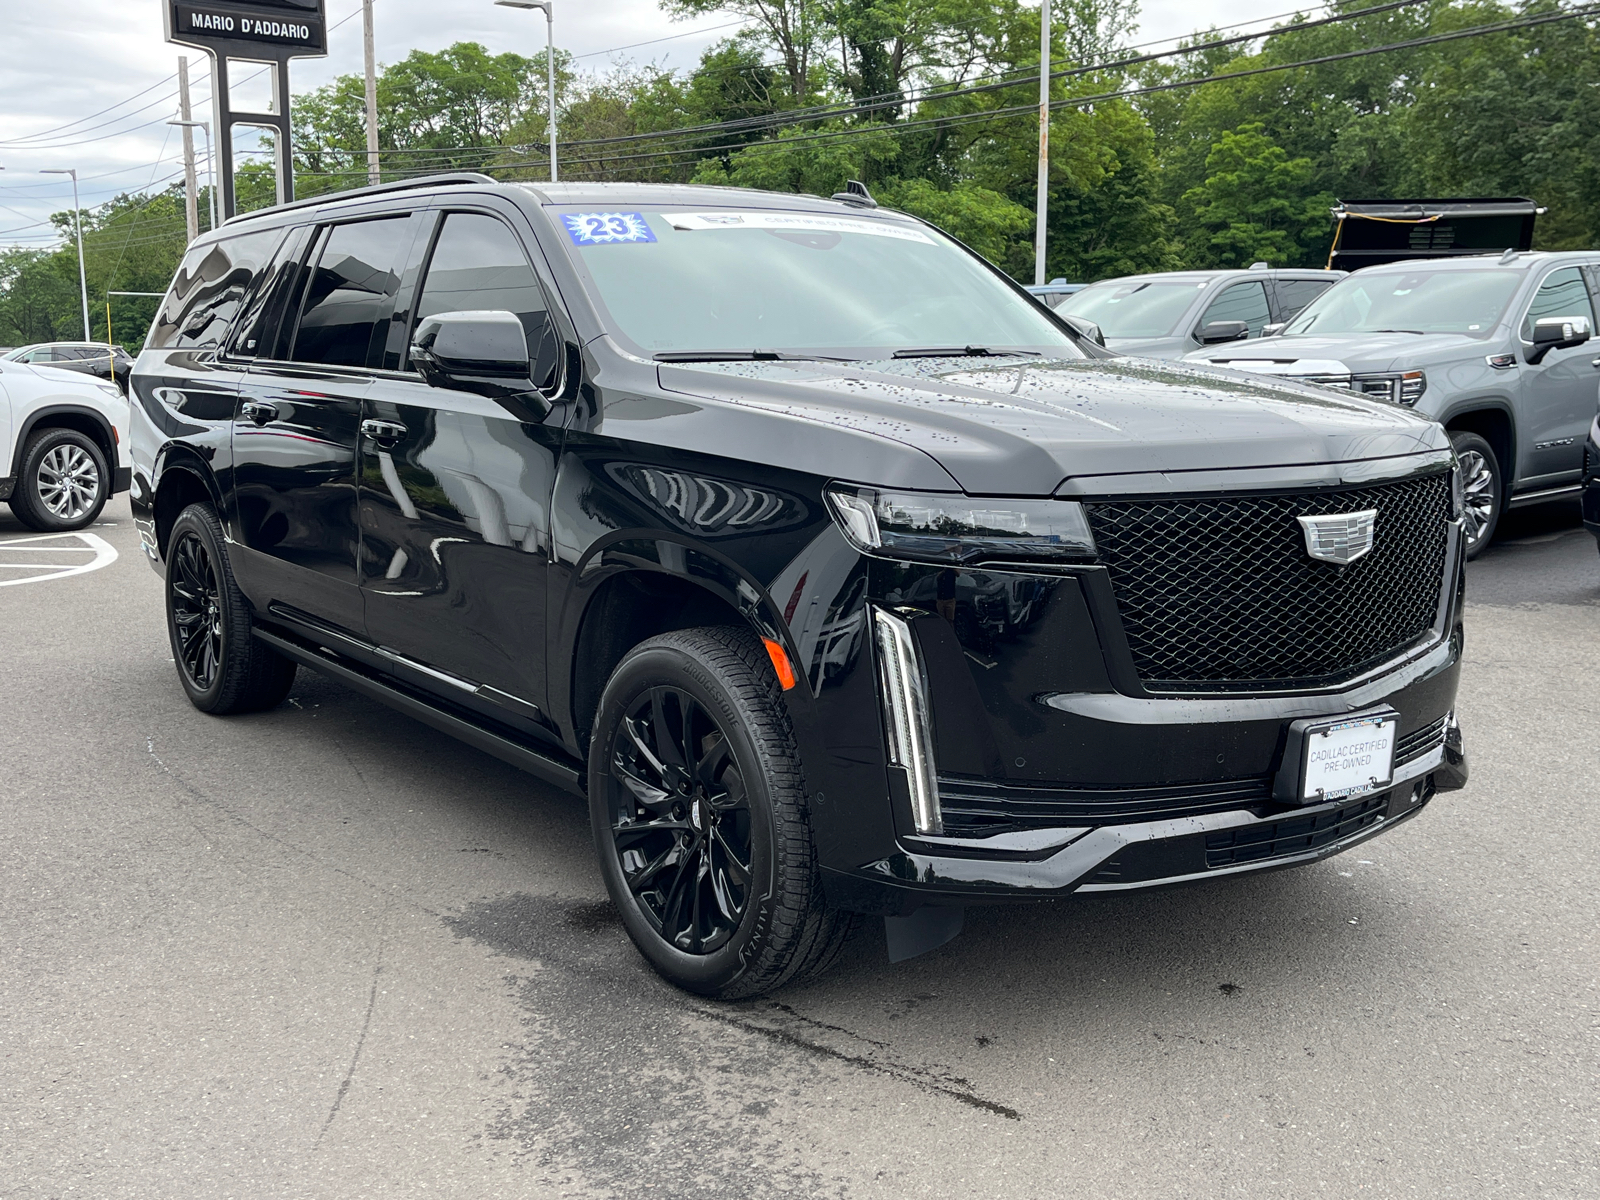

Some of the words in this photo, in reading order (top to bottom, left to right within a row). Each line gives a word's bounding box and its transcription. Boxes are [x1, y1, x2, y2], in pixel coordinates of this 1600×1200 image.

[192, 13, 234, 31] MARIO
[242, 18, 309, 39] D'ADDARIO
[586, 217, 630, 236] 23
[682, 661, 740, 730] BRIDGESTONE
[1311, 745, 1348, 763] CADILLAC
[1349, 738, 1388, 756] CERTIFIED
[1324, 754, 1372, 773] PRE-OWNED
[744, 904, 768, 957] ALENZA
